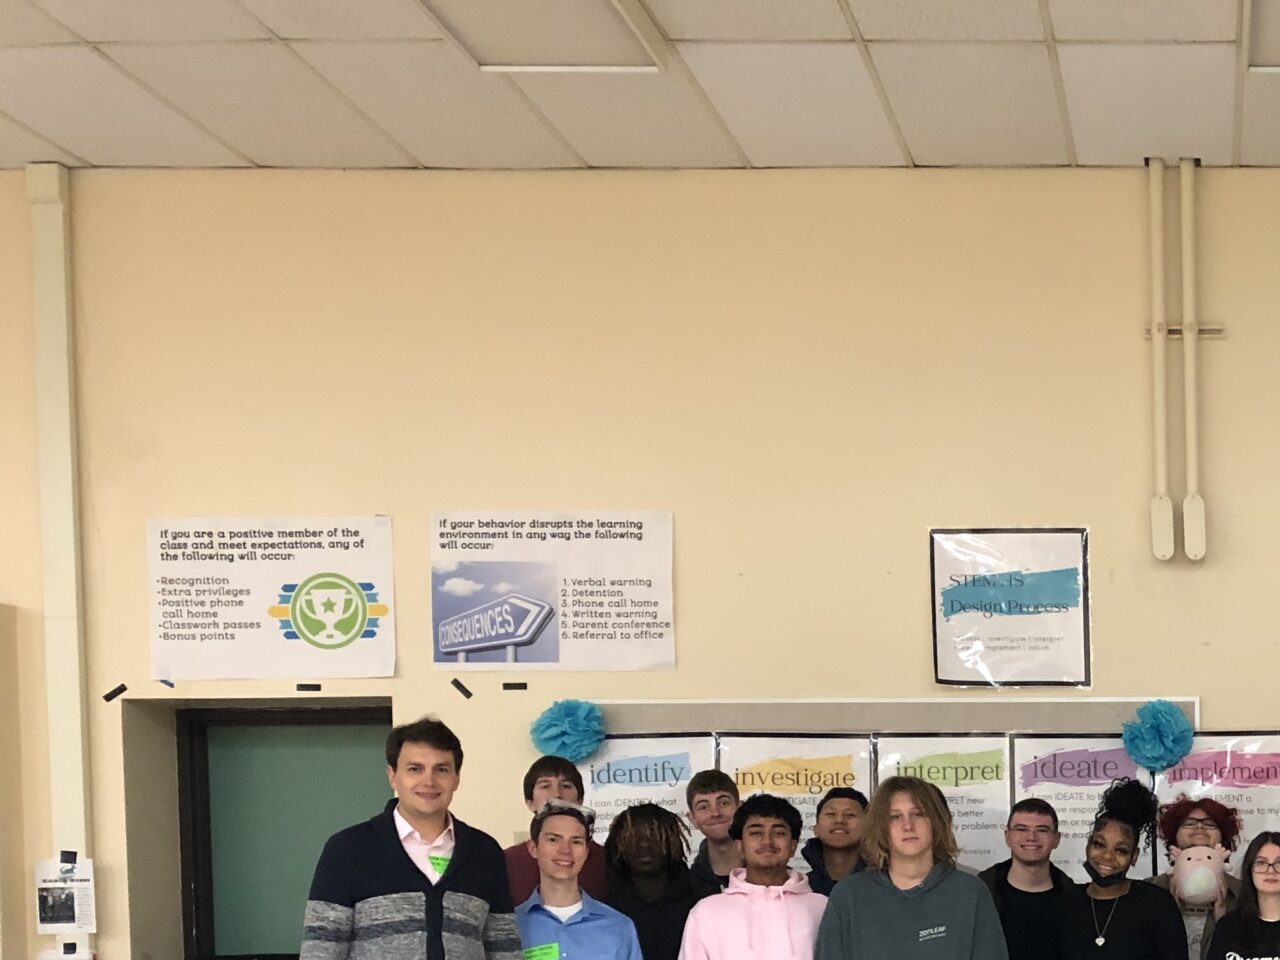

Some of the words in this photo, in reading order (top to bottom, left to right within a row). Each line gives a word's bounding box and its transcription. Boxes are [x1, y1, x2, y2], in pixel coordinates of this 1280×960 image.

[439, 519, 447, 528] If
[450, 520, 474, 529] your
[478, 519, 525, 528] behavior
[529, 519, 573, 529] disrupts
[576, 519, 593, 528] the
[597, 519, 642, 529] learning
[160, 529, 168, 538] If
[171, 531, 190, 540] you
[194, 530, 213, 538] are
[229, 529, 274, 540] positive
[278, 529, 323, 538] member
[327, 528, 338, 537] of
[341, 528, 359, 537] the
[439, 530, 509, 539] environment
[512, 530, 522, 538] in
[526, 531, 546, 540] any
[550, 531, 570, 540] way
[574, 530, 591, 538] the
[595, 530, 642, 540] following
[160, 541, 187, 550] class
[192, 541, 213, 549] and
[218, 541, 247, 549] meet
[251, 540, 325, 551] expectations,
[328, 540, 349, 550] any
[353, 539, 364, 548] of
[439, 541, 457, 549] will
[461, 541, 494, 549] occur:
[160, 552, 178, 561] the
[182, 551, 234, 562] following
[238, 551, 257, 560] will
[261, 552, 295, 561] occur:
[161, 576, 229, 586] Recognition
[571, 578, 606, 586] Verbal
[609, 578, 652, 588] warning
[161, 588, 191, 596] Extra
[195, 587, 250, 597] privileges
[572, 589, 623, 597] Detention
[162, 599, 206, 607] Positive
[210, 598, 244, 608] phone
[572, 599, 604, 607] Phone
[608, 599, 627, 607] call
[630, 599, 658, 607] home
[162, 609, 183, 618] call
[187, 609, 218, 617] home
[950, 600, 1003, 618] Design
[1007, 600, 1069, 613] Process
[572, 610, 611, 618] Written
[615, 610, 657, 619] warning
[162, 620, 220, 629] Classwork
[223, 621, 261, 632] passes
[441, 604, 514, 645] CONSEQUENCES
[572, 621, 608, 629] Parent
[611, 620, 670, 629] conference
[163, 632, 196, 640] Bonus
[200, 632, 235, 642] points
[572, 631, 616, 639] Referral
[620, 631, 630, 639] to
[634, 630, 664, 639] office
[1033, 753, 1119, 779] ideate
[590, 760, 685, 787] identify
[895, 762, 1003, 787] interpret
[735, 767, 855, 794] investigate
[957, 809, 984, 817] better
[1267, 808, 1279, 816] my
[961, 822, 998, 832] problem
